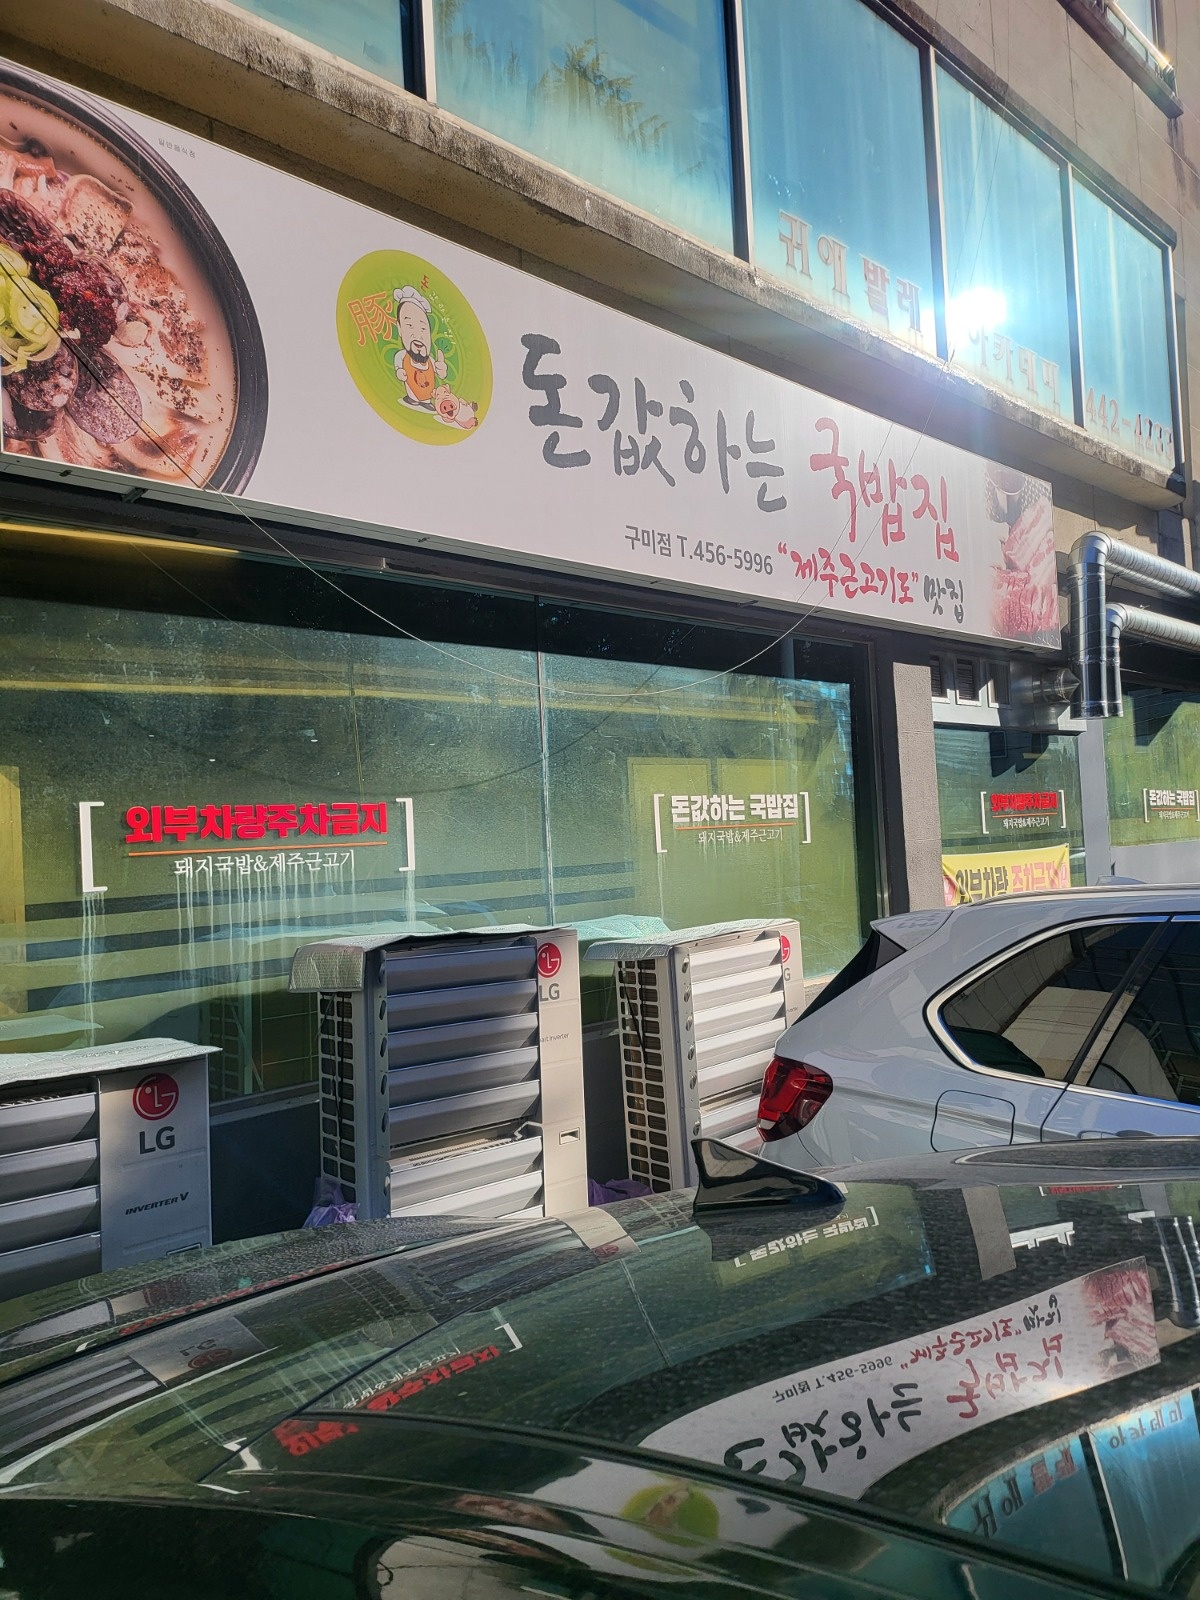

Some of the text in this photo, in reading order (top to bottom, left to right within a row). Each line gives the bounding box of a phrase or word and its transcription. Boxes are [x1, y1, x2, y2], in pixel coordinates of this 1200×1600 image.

[859, 253, 922, 336] 발레
[346, 291, 399, 346] 豚
[520, 333, 960, 562] 돈값하는 국밥집
[625, 525, 773, 575] 구미점 T.456-5996
[923, 574, 964, 624] 맛집
[125, 802, 389, 844] 외부차량주차금지
[671, 793, 799, 823] 돈값하는 국밥집
[174, 850, 355, 878] 돼지국밥&제주근고기
[538, 983, 560, 1002] LG
[139, 1126, 176, 1155] LG
[125, 1192, 189, 1215] INVERTER V
